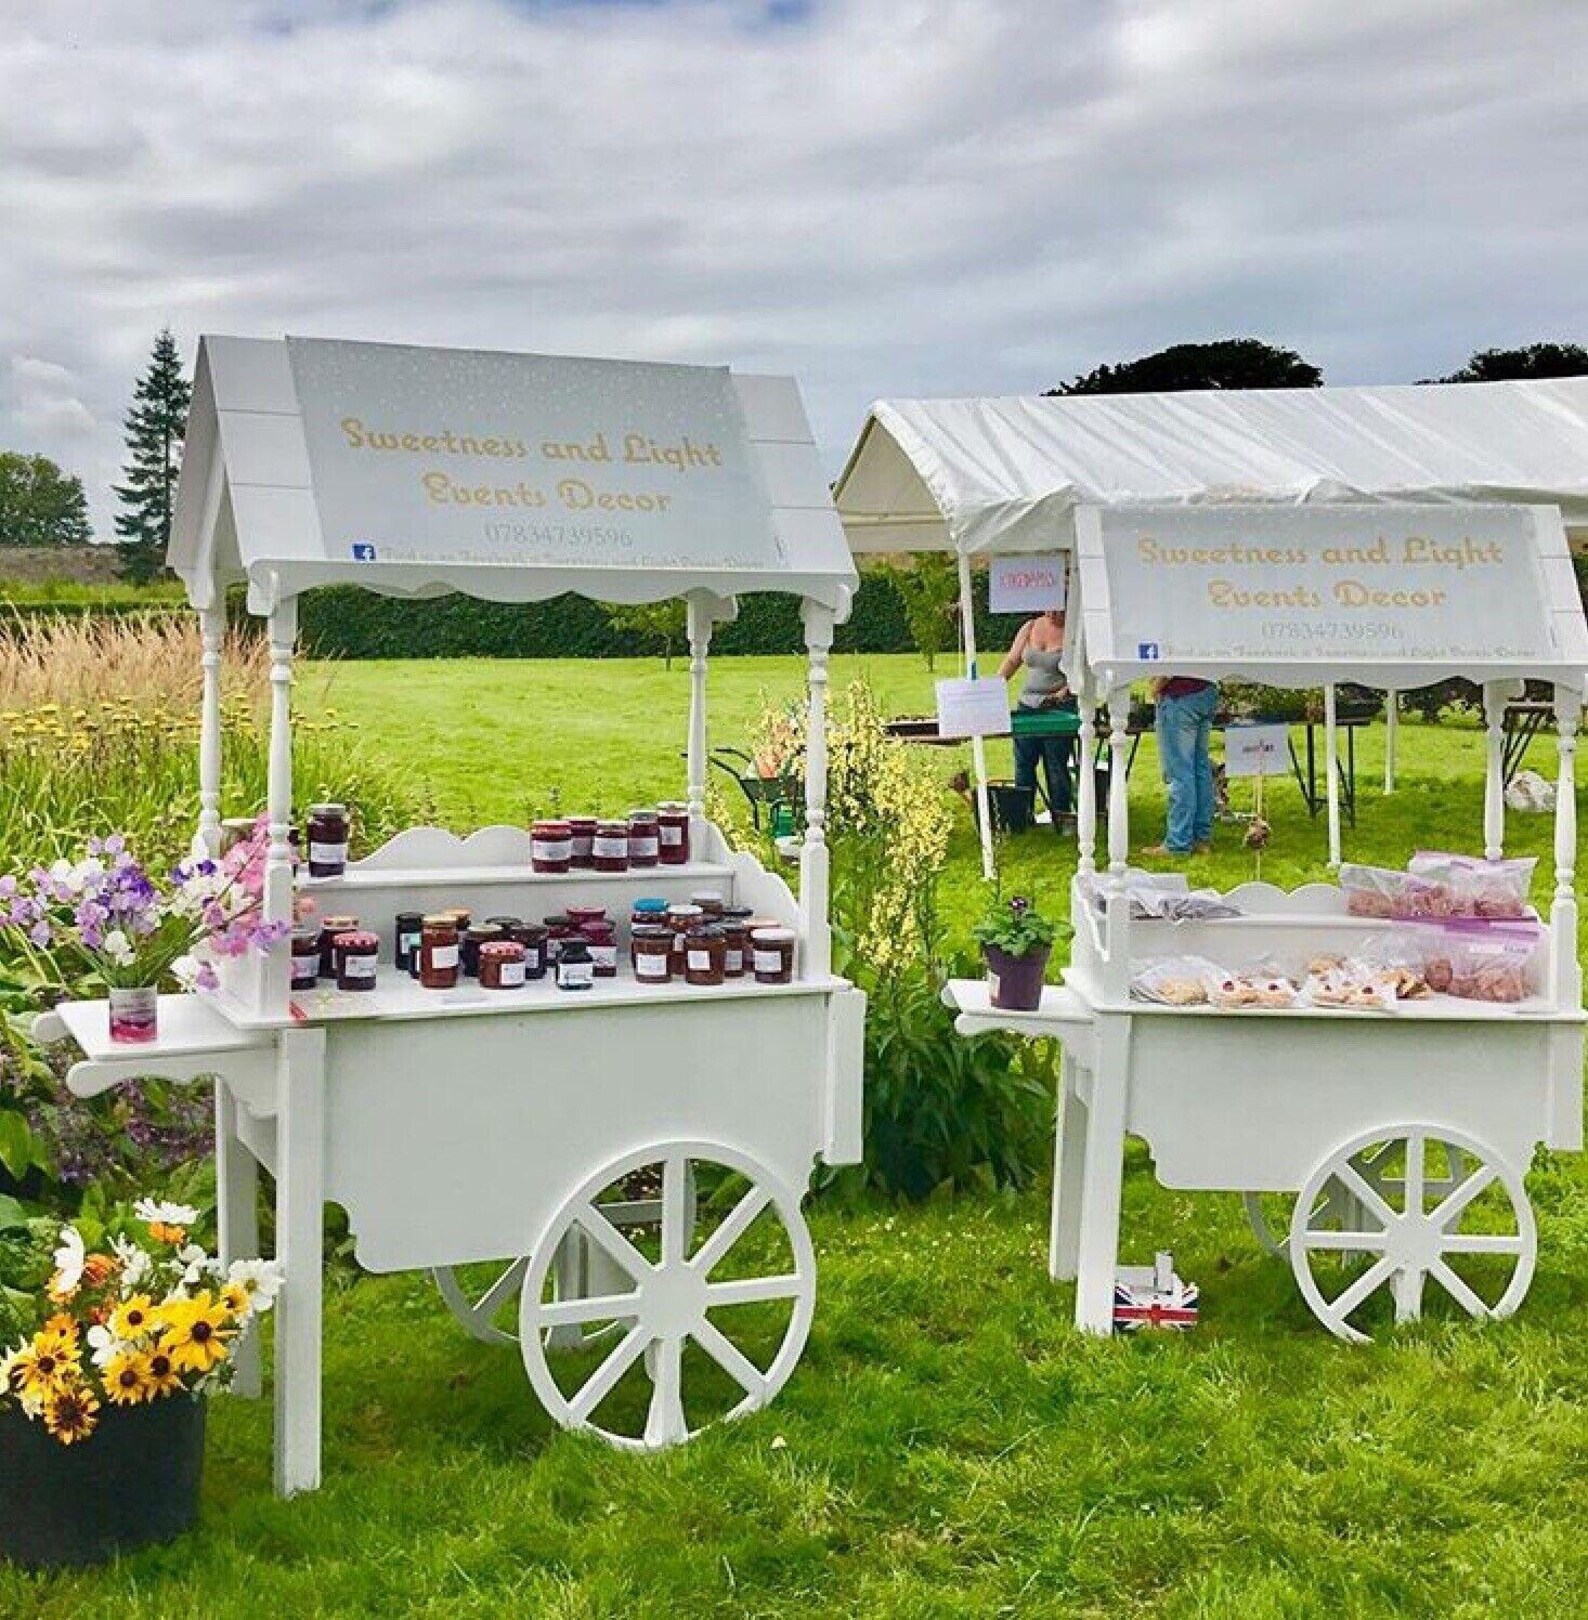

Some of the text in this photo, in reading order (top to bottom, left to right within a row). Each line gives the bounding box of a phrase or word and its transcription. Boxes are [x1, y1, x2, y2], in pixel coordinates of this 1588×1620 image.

[341, 417, 723, 472] Sweetness and Light
[421, 471, 672, 513] Events Decor
[1137, 534, 1504, 571] Sweetness and Light
[1206, 578, 1447, 609] Events Decor
